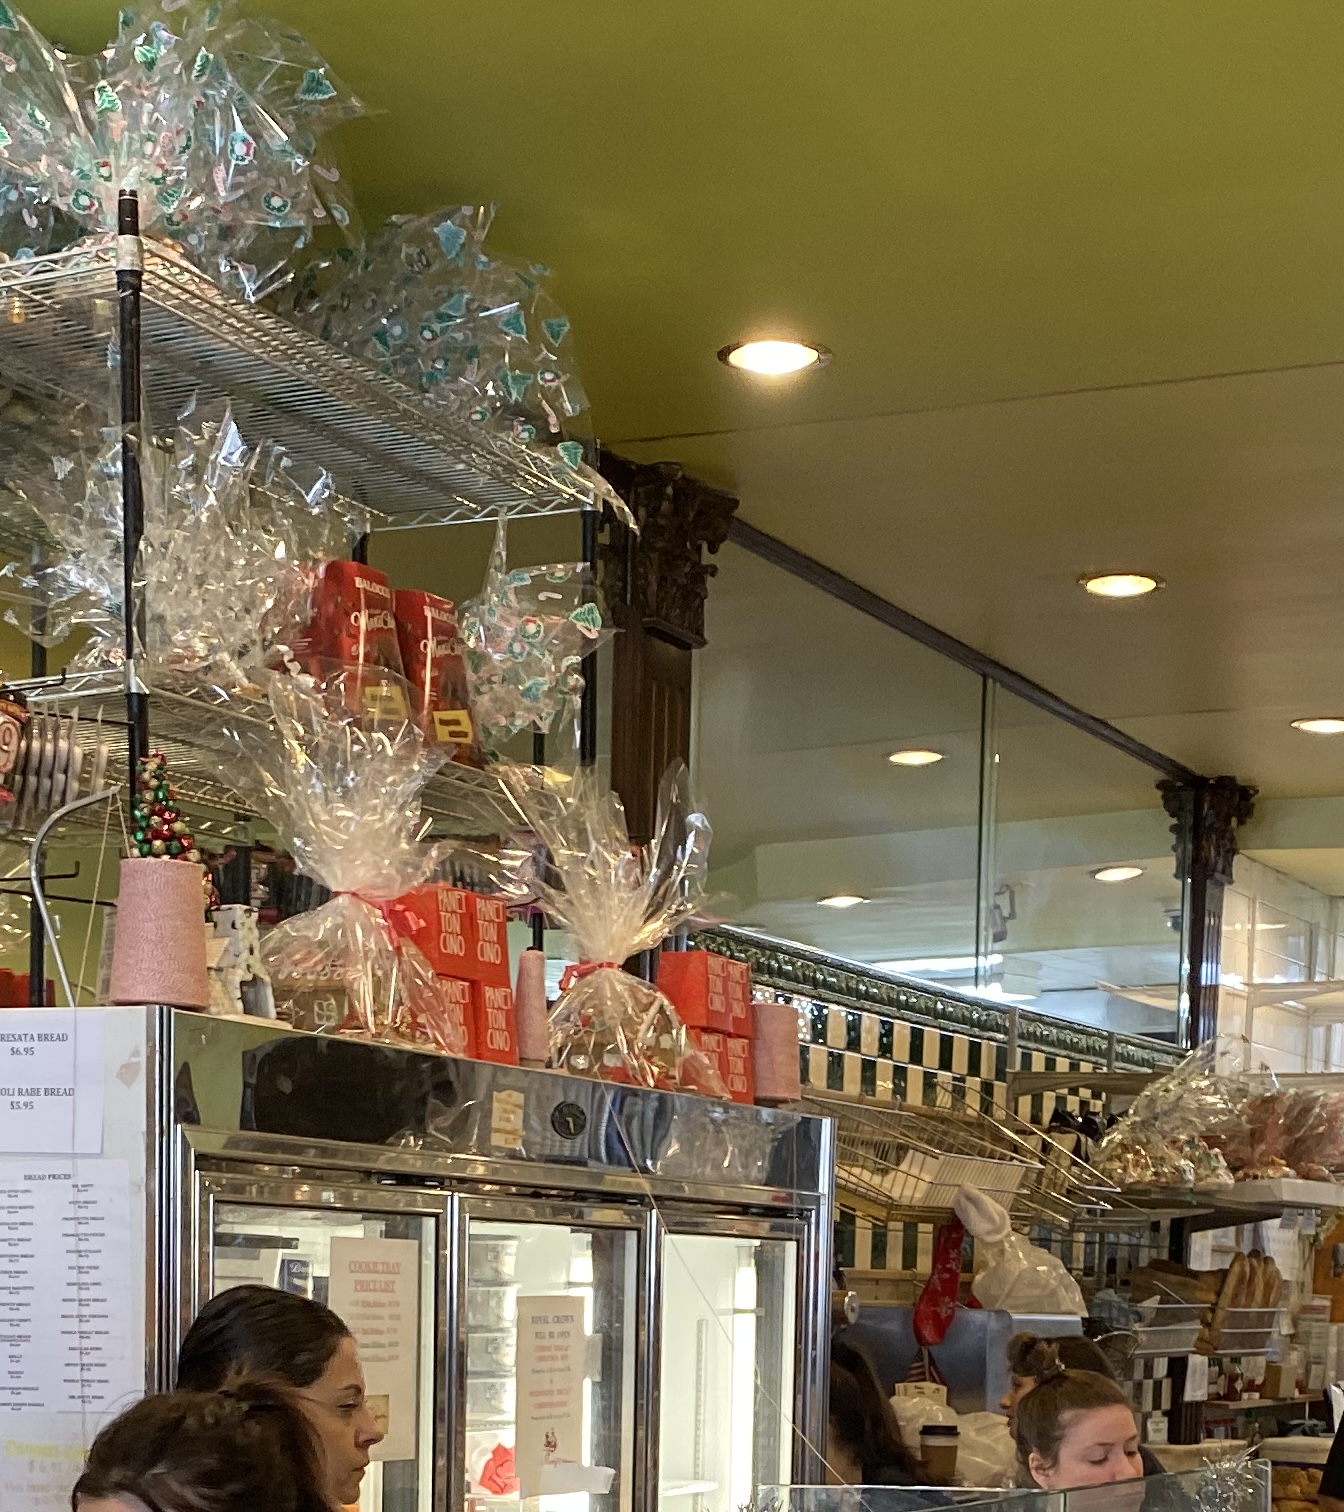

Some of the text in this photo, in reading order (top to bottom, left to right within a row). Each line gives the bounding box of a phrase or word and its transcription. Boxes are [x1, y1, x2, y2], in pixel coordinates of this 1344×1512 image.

[37, 1033, 69, 1042] BREAD
[10, 1047, 35, 1056] $6.95
[17, 1087, 42, 1097] RABE
[44, 1087, 74, 1097] BREAD
[10, 1101, 34, 1110] $5.95
